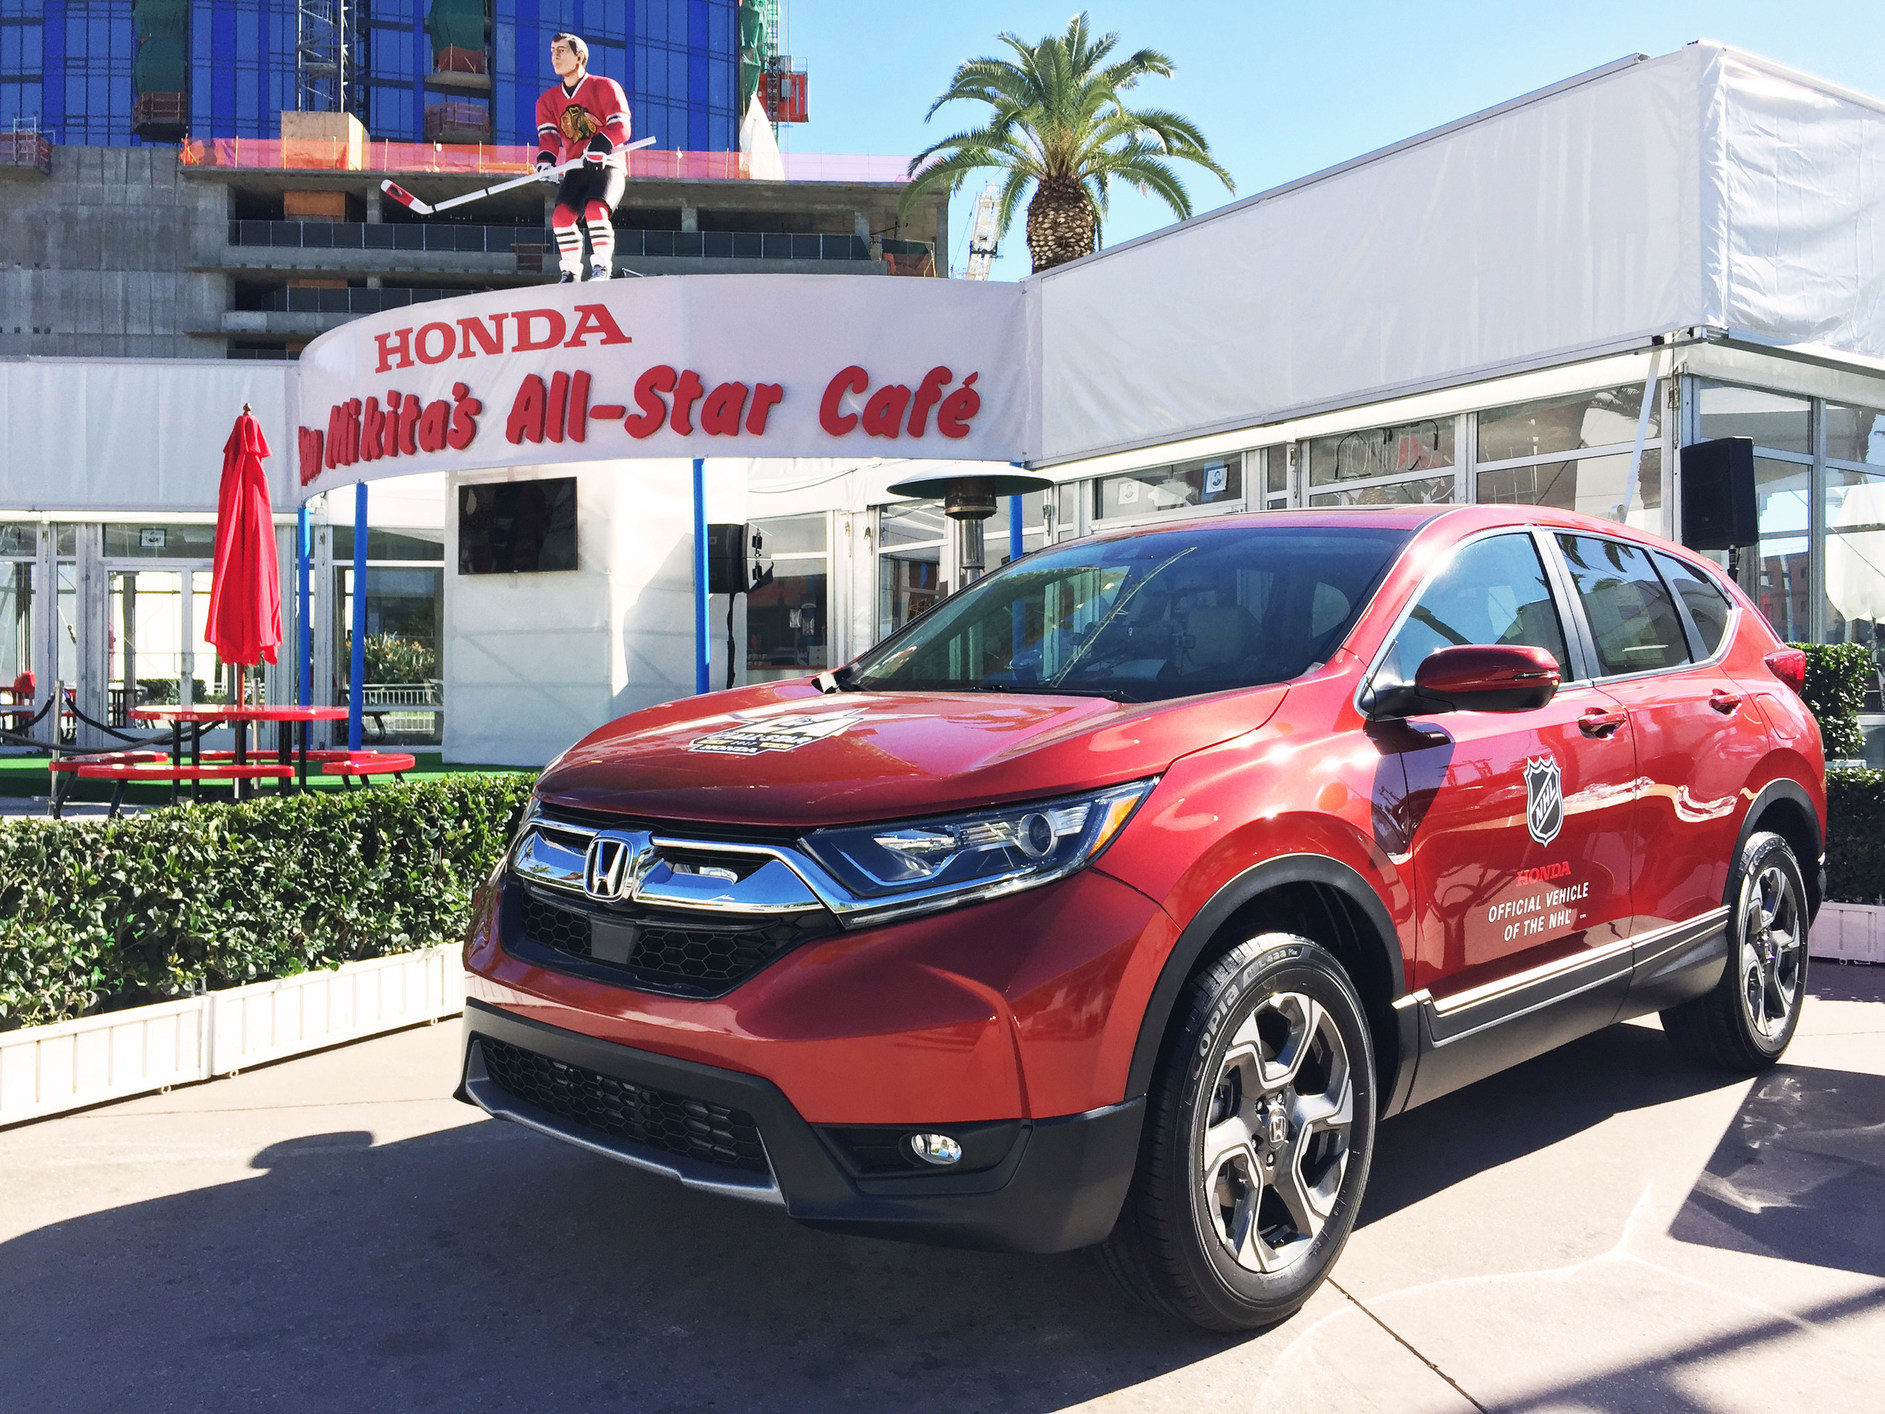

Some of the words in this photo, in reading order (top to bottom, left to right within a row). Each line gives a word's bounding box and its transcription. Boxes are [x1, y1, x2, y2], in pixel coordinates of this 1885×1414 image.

[374, 303, 632, 374] HONDA
[325, 381, 482, 469] Mikita's
[505, 364, 784, 445] All-Star
[819, 366, 981, 439] Café
[1535, 778, 1557, 828] NHL
[1516, 861, 1571, 887] HONDA
[1488, 895, 1541, 923] OFFICIAL
[1546, 881, 1589, 908] VEHICLE
[1504, 922, 1520, 942] OF
[1524, 915, 1545, 936] THE
